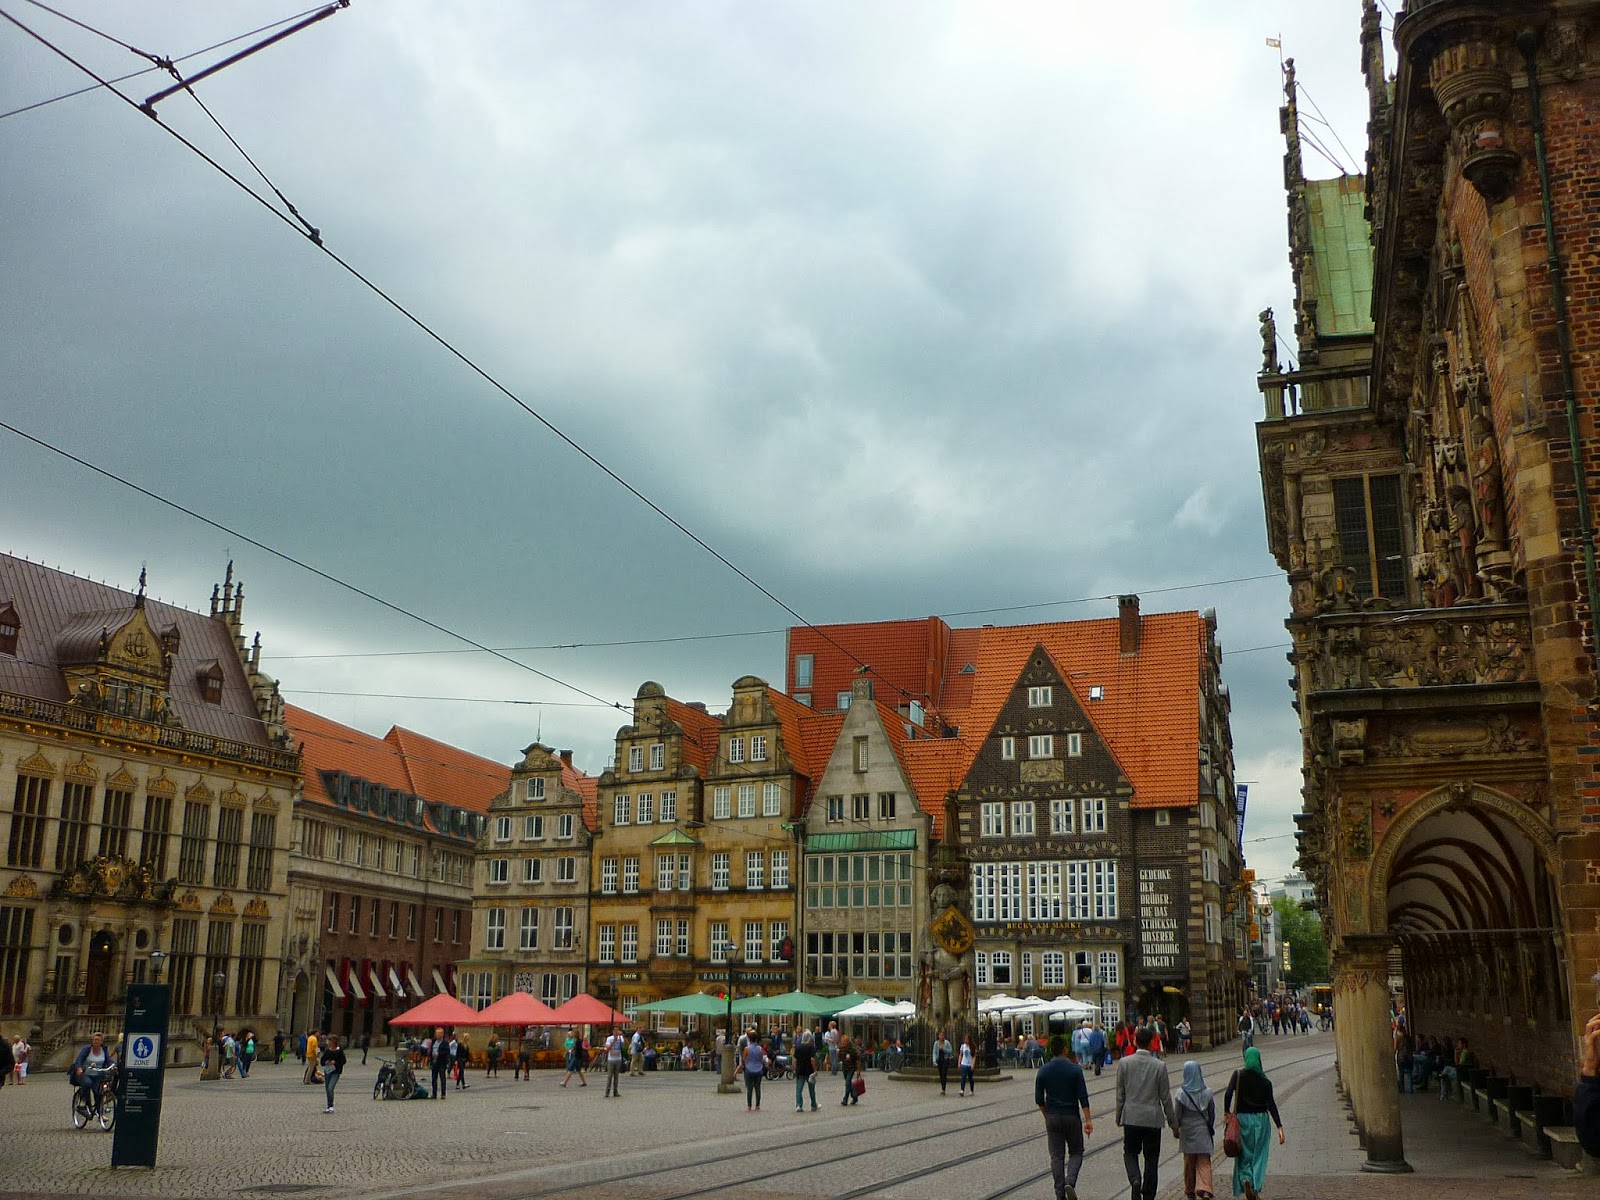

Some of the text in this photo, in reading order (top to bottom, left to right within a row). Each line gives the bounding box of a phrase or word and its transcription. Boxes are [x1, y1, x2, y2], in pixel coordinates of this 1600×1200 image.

[1139, 869, 1171, 880] GEDENKE
[1140, 882, 1154, 893] DER
[1141, 907, 1168, 917] DIE DAS
[1141, 918, 1178, 930] SCHICKSAL
[1142, 931, 1174, 942] UNSERER
[1142, 944, 1180, 954] TRENNUNG
